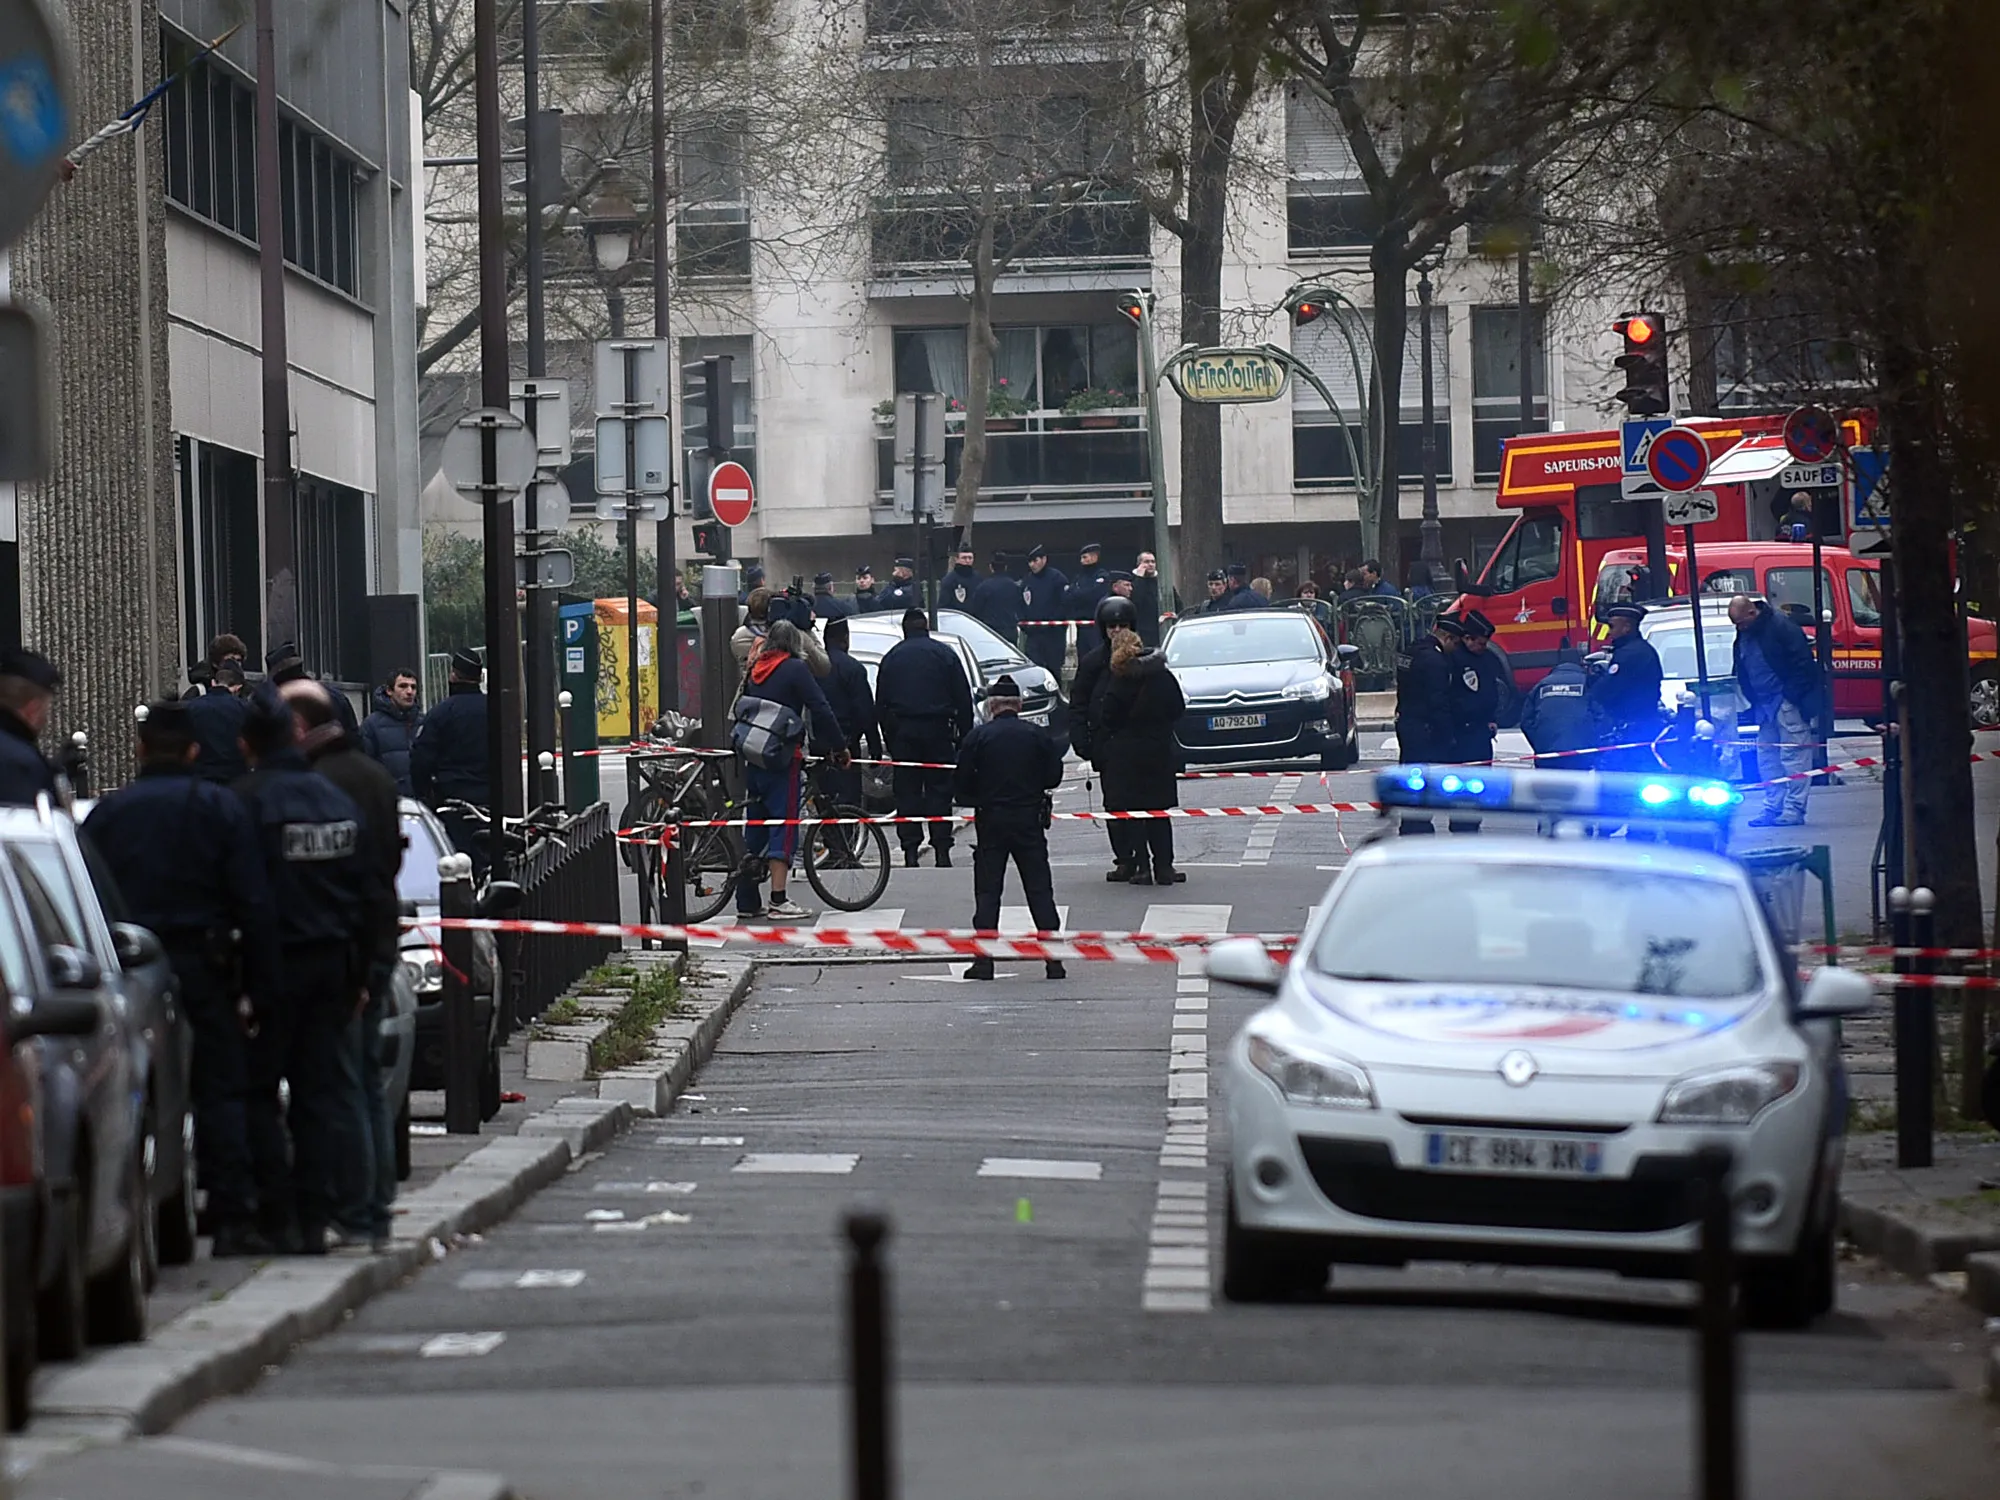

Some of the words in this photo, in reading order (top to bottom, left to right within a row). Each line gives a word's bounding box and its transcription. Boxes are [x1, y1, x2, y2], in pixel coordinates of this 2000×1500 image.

[1187, 358, 1277, 397] METROPOLITAIN
[1784, 470, 1819, 482] SAUF
[566, 620, 579, 638] P
